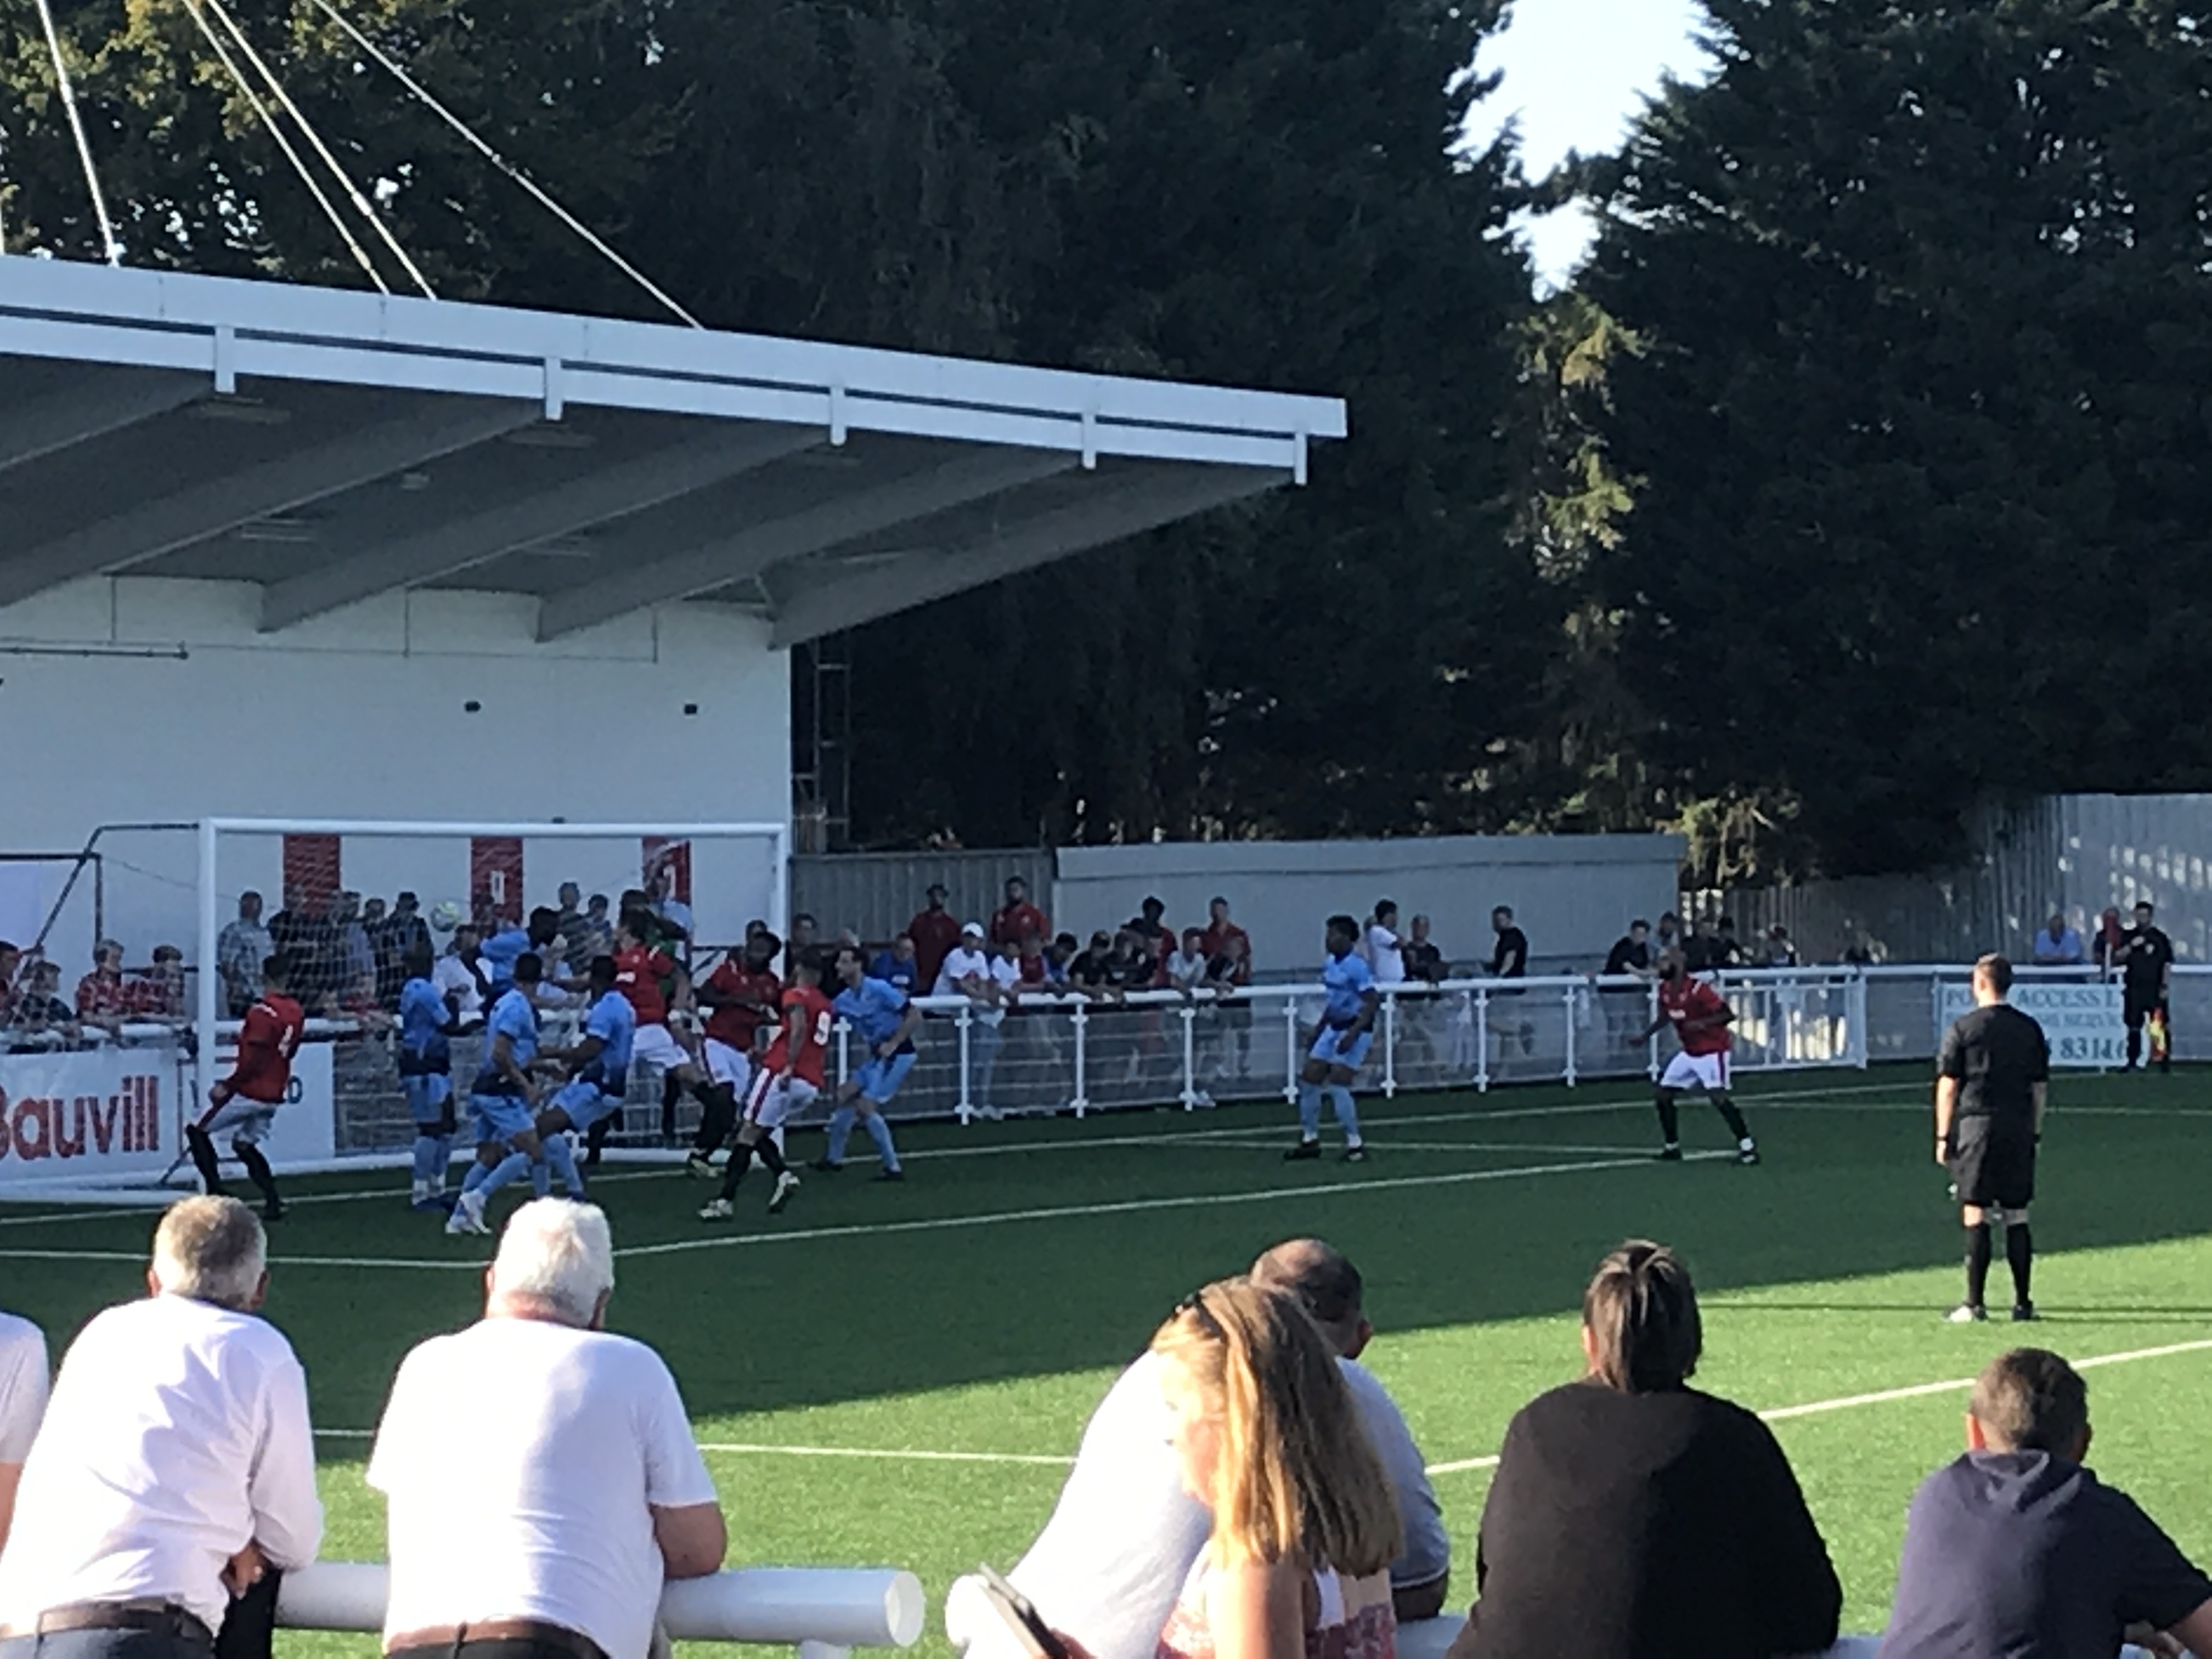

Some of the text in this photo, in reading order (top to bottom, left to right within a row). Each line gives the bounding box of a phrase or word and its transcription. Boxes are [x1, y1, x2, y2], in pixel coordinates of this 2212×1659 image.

[2017, 989, 2101, 1007] ACCESS
[813, 1011, 831, 1046] 9
[0, 1075, 159, 1161] auvill
